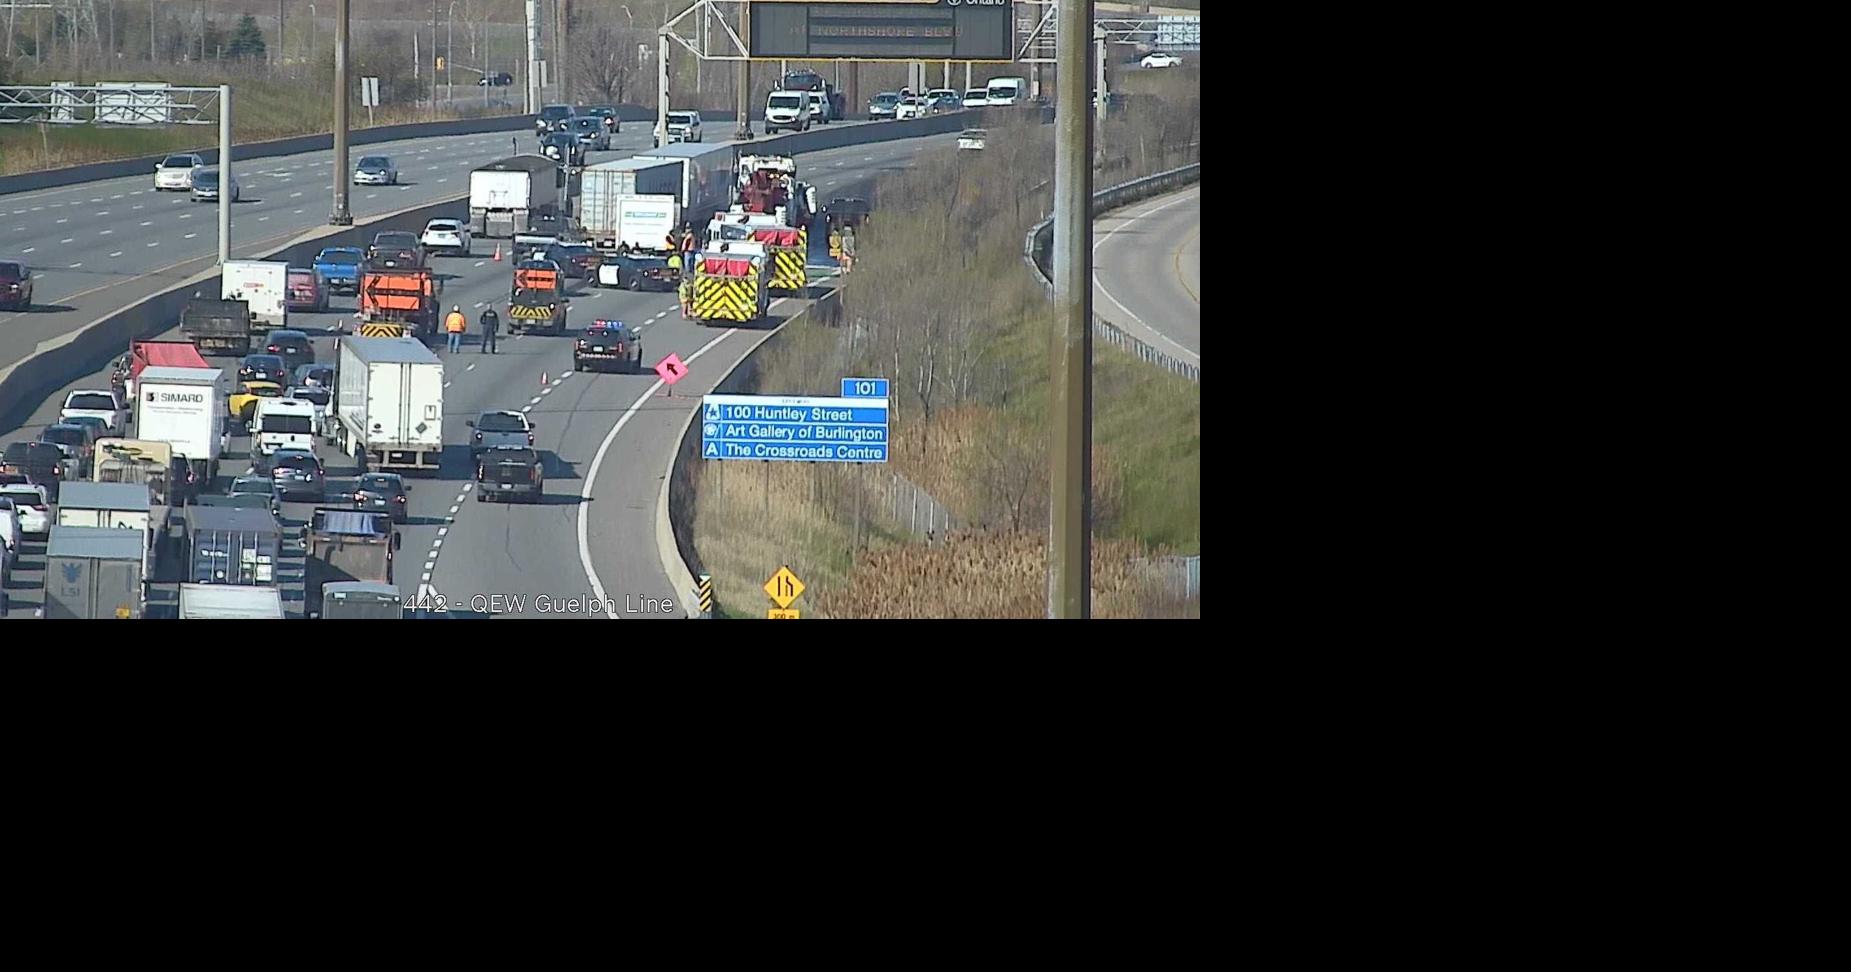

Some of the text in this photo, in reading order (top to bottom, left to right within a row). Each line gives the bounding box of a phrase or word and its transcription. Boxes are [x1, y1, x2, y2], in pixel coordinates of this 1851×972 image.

[817, 25, 915, 37] NORTHSHORE
[854, 382, 876, 395] 101
[160, 393, 204, 403] SIMARD
[726, 408, 853, 423] 100 Huntley Street
[725, 425, 883, 442] Art Gallery of Burlington
[726, 443, 883, 459] The Crossroads Centre
